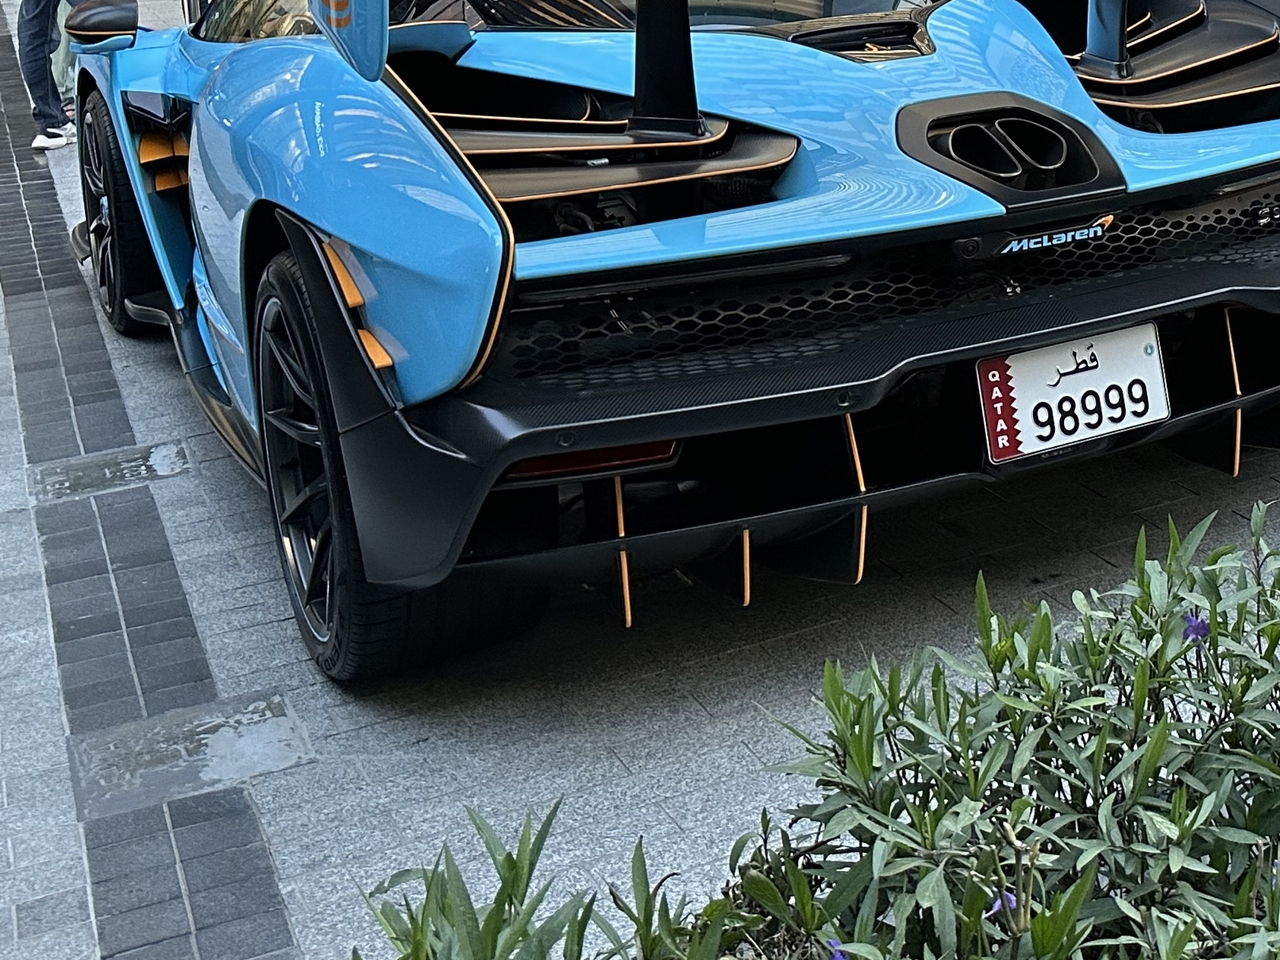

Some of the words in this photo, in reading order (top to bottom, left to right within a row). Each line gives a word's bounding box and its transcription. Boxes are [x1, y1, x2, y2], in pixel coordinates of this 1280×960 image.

[1001, 225, 1104, 254] McLaren
[1047, 341, 1100, 387] قطر
[987, 370, 1010, 449] QATAR
[1032, 378, 1150, 442] 98999
